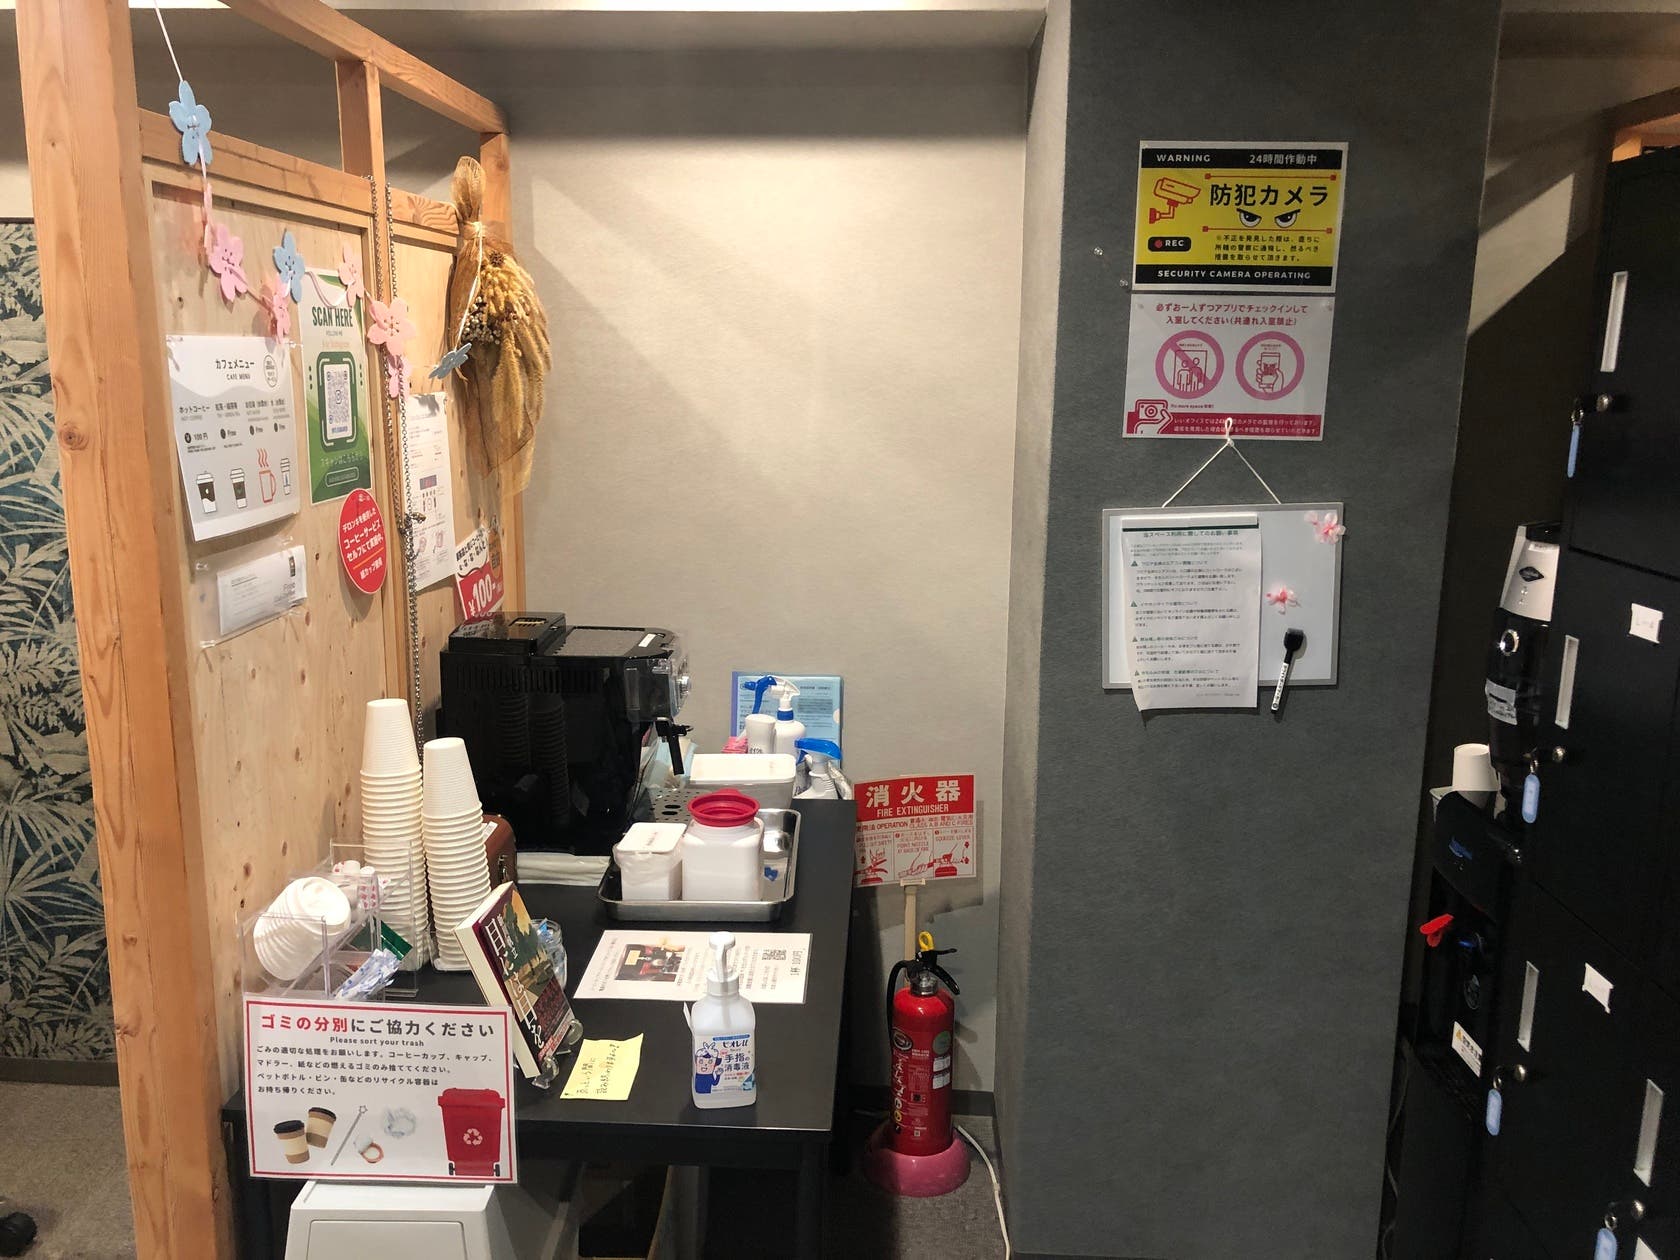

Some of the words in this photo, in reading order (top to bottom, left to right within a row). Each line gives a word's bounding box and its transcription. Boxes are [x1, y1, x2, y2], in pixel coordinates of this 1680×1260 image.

[1156, 154, 1211, 162] WARNING
[1249, 154, 1318, 165] 24時間作動中
[1210, 183, 1328, 206] 防犯カメラ
[1165, 239, 1185, 247] REC
[1157, 270, 1206, 278] SECURITY
[1209, 270, 1251, 278] CAMERA
[1254, 271, 1311, 280] OPERATING
[311, 306, 334, 327] SCAN
[334, 307, 353, 328] HERE
[215, 359, 256, 370] カフェメニュー
[179, 405, 211, 414] ホットコーヒー
[343, 519, 381, 550] コーヒーサービス
[865, 779, 961, 808] 消火器
[876, 808, 893, 818] FIRE
[896, 803, 949, 816] EXTINGUISHER
[877, 822, 908, 830] OPERATION
[485, 917, 546, 1049] 目には目を
[262, 1013, 495, 1037] ゴミの分別にご協力ください
[360, 1037, 378, 1045] sort
[380, 1039, 399, 1047] your
[256, 1045, 492, 1062] ごみの適切な処理をお願いします。コーヒーカップ、キャップ、
[724, 1053, 750, 1064] 手指の
[724, 1062, 750, 1072] 消毒液
[258, 1086, 336, 1096] お持ち帰りください。
